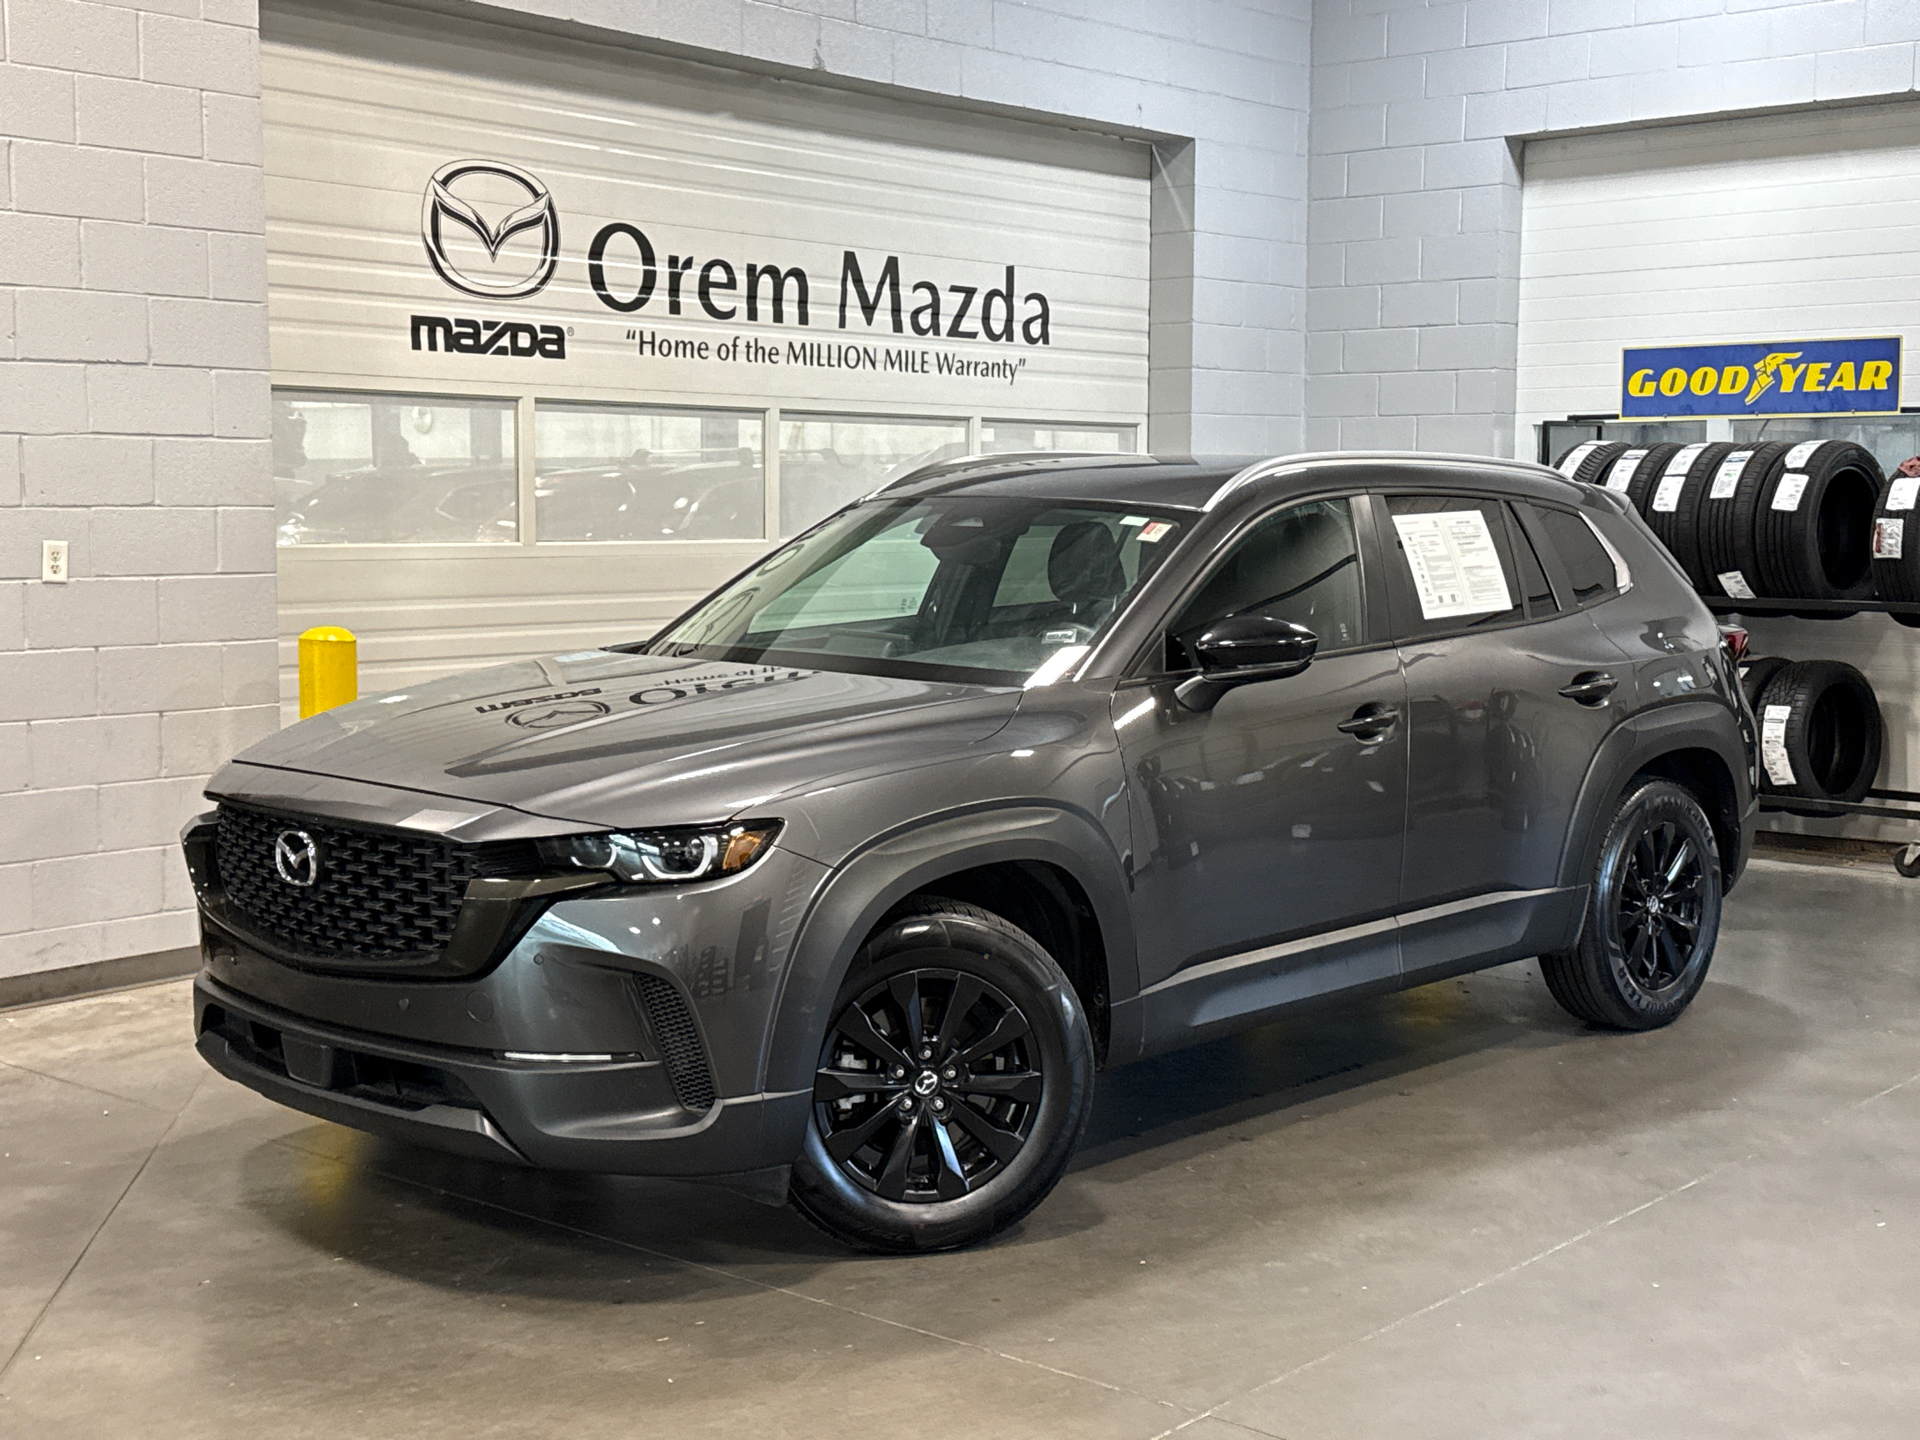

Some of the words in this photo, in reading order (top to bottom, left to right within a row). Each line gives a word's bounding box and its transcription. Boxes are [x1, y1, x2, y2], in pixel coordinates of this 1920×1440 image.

[587, 221, 810, 327] Orem
[838, 250, 1051, 346] Mazda
[410, 314, 566, 360] mazda
[716, 335, 742, 362] of
[744, 338, 781, 365] the
[785, 341, 878, 370] MILLION
[883, 348, 930, 374] MILE
